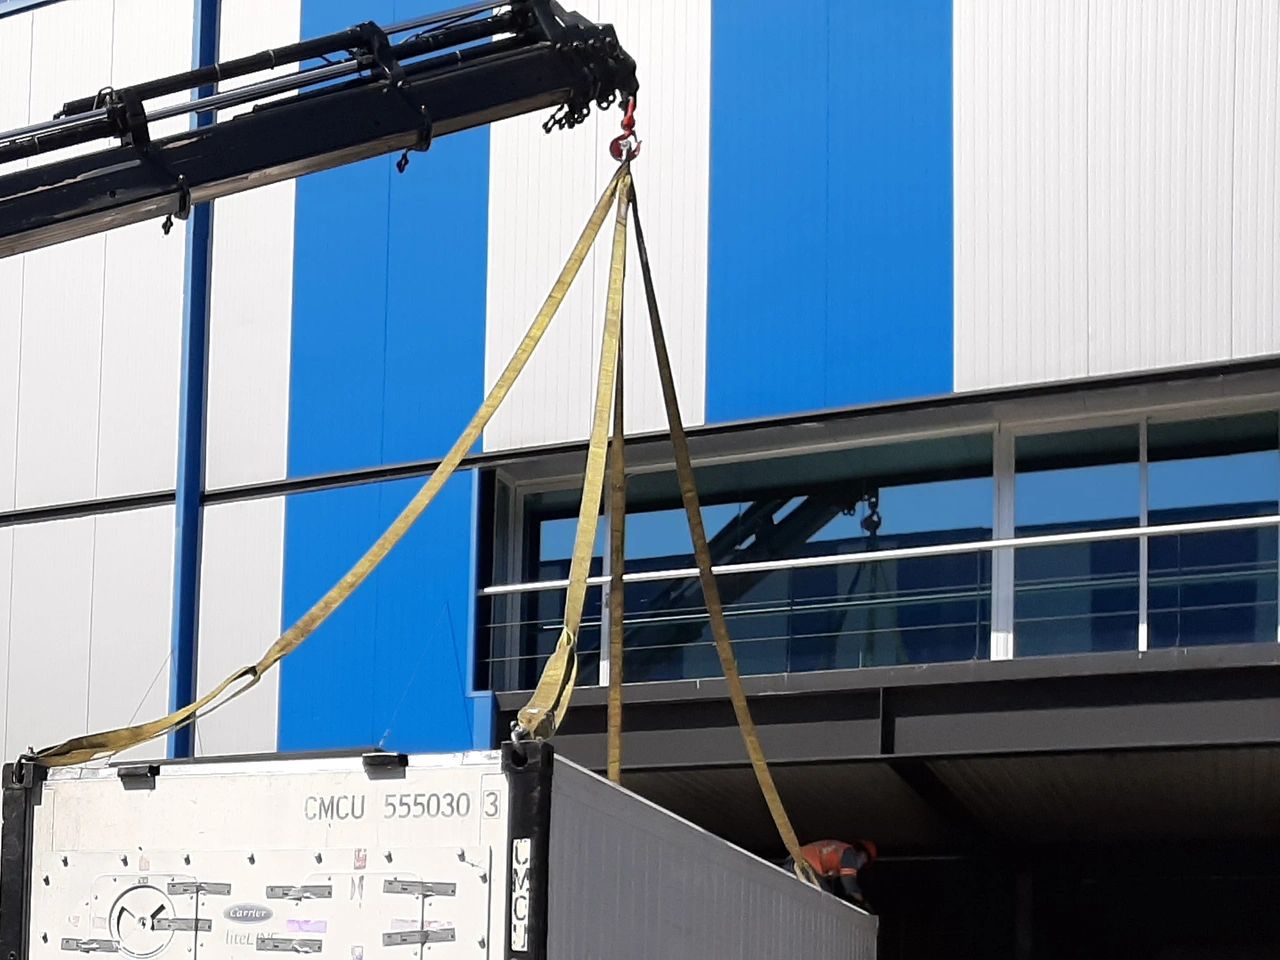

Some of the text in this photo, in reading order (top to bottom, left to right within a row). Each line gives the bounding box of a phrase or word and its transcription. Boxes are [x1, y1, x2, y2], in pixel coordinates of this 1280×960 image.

[304, 791, 499, 820] CMCU 555030 3
[512, 840, 531, 949] CMCU
[229, 907, 267, 919] Carrier
